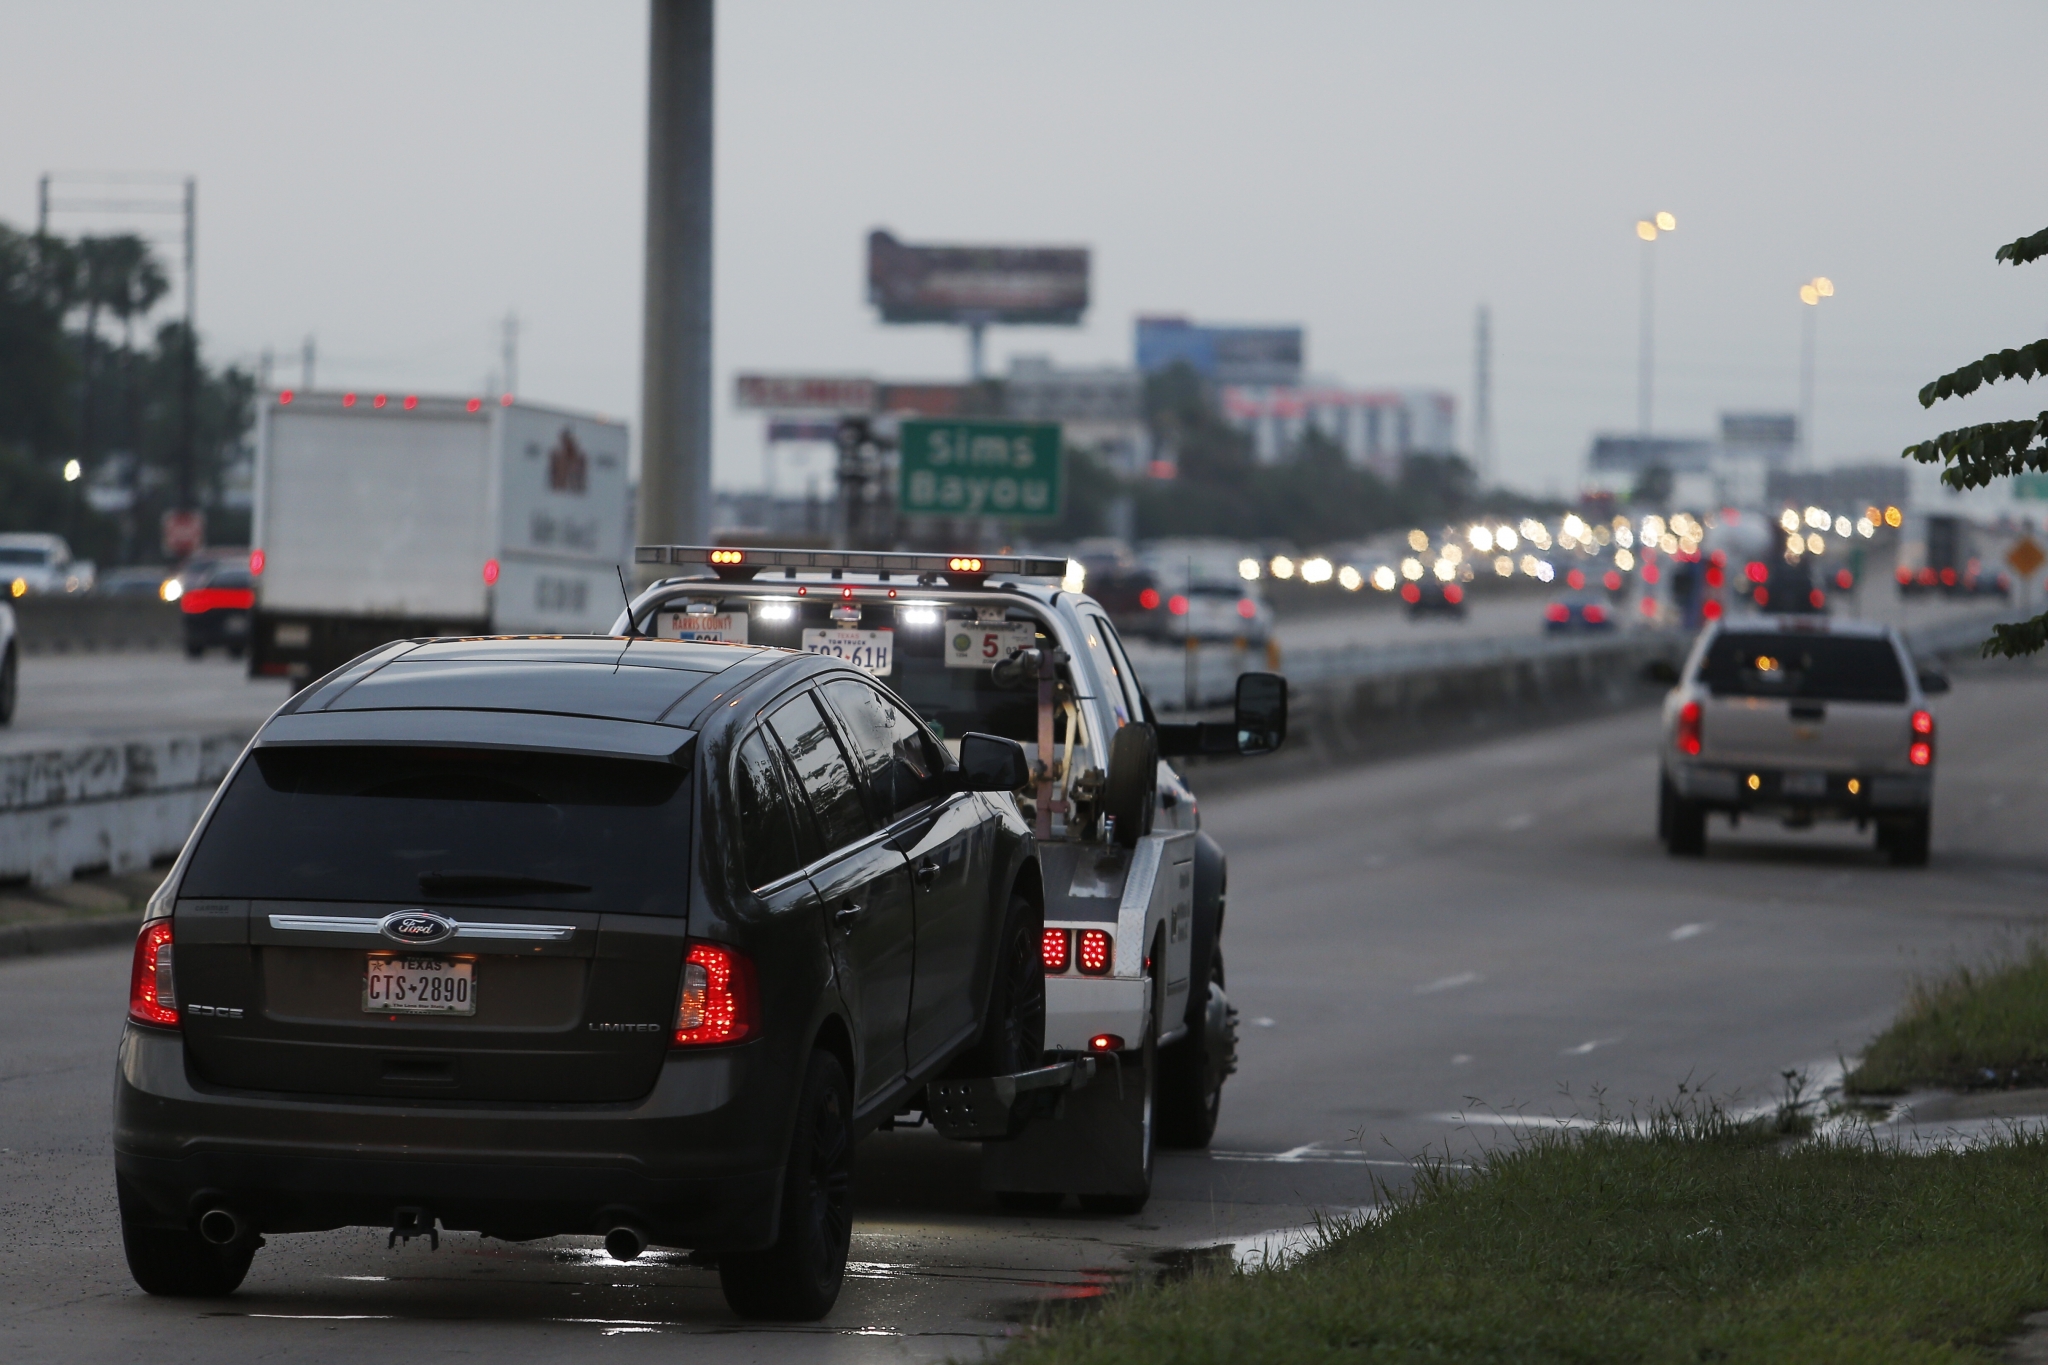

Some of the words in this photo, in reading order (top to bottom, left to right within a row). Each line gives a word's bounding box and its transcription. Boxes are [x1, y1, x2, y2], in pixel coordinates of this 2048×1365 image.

[928, 428, 1036, 468] Sims
[910, 470, 1049, 514] Bayou
[672, 617, 700, 630] HARRIS
[702, 616, 732, 630] COUNTY
[982, 634, 998, 657] 5
[398, 918, 434, 934] Ford
[401, 960, 442, 971] TEXAS
[188, 1004, 244, 1019] EDGE
[588, 1022, 661, 1032] LIMITED
